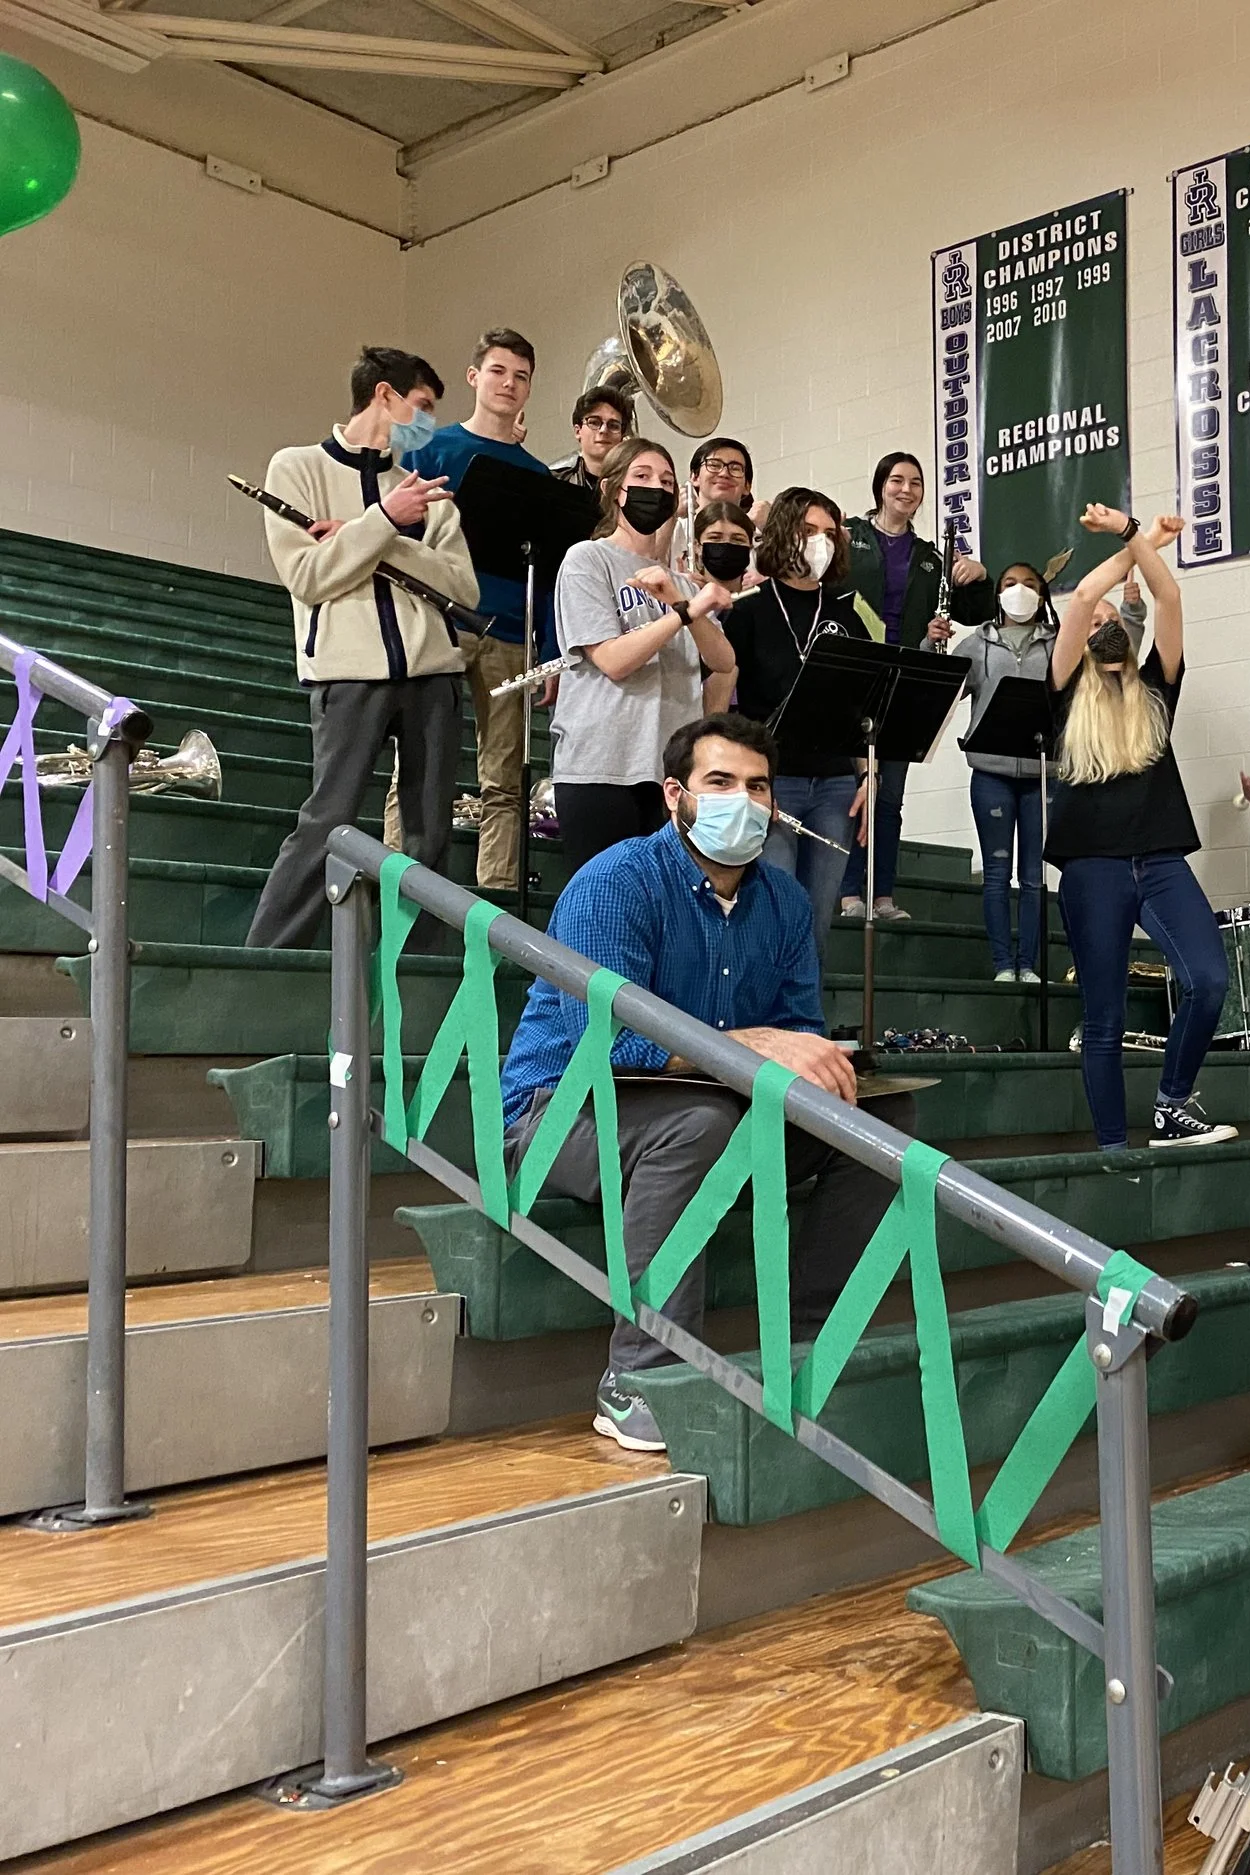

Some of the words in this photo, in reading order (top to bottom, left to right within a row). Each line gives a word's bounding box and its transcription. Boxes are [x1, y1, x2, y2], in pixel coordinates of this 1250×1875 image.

[983, 231, 1118, 289] CHAMPIONS
[998, 210, 1102, 261] DISTRICT
[1180, 220, 1225, 257] GIRLS
[986, 291, 1018, 317] 1996
[1030, 276, 1064, 304] 1997
[1076, 262, 1111, 290] 1999
[940, 300, 972, 330] BOYS
[986, 315, 1022, 343] 2007
[1033, 299, 1067, 327] 2010
[943, 330, 971, 486] OUTDOOR
[998, 403, 1107, 448] REGIONAL
[1186, 258, 1224, 558] LACROSSE
[986, 426, 1120, 476] CHAMPIONS
